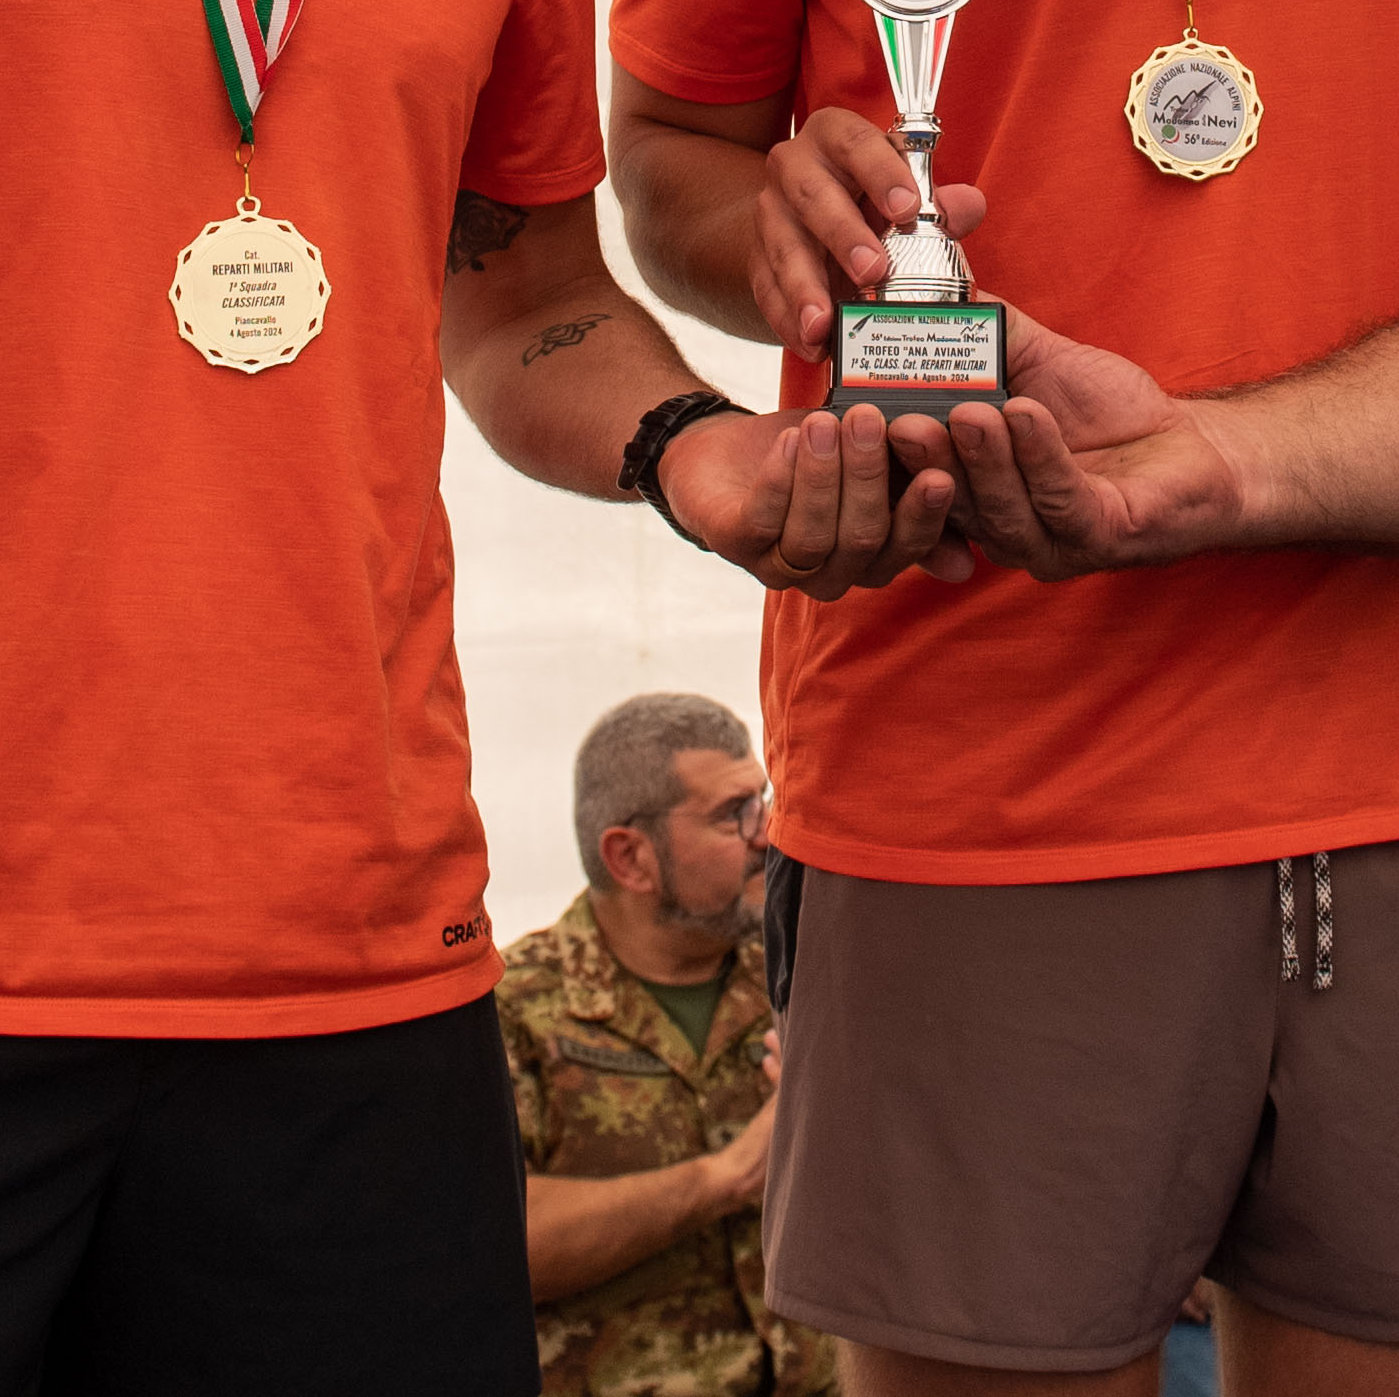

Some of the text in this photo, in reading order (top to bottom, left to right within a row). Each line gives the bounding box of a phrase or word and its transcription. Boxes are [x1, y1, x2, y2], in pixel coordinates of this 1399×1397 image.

[1149, 62, 1241, 111] ASSOCIAZIONE NAZIONALE ALPINI
[1153, 111, 1201, 126] Madonna
[1207, 115, 1237, 128] Nevi
[244, 250, 260, 260] Cat.
[212, 261, 293, 276] REPARTI MILITARI
[240, 280, 277, 294] Squadra
[222, 295, 285, 308] CLASSIFICATA
[235, 315, 276, 325] Piancavallo
[873, 315, 974, 325] ASSOCIAZIONE NAZIONALE ALPINI
[237, 328, 261, 339] Agosto
[263, 327, 283, 337] 2024
[902, 334, 925, 342] Trofeo
[966, 333, 989, 343] Nevi
[863, 345, 900, 356] TROFEO
[874, 358, 900, 370] CLASS.
[902, 358, 917, 370] Cat.
[920, 359, 952, 371] REPARTI
[953, 360, 987, 371] MILITARI
[869, 372, 909, 381] Piancavallo
[922, 373, 947, 383] Agosto
[950, 374, 969, 382] 2024
